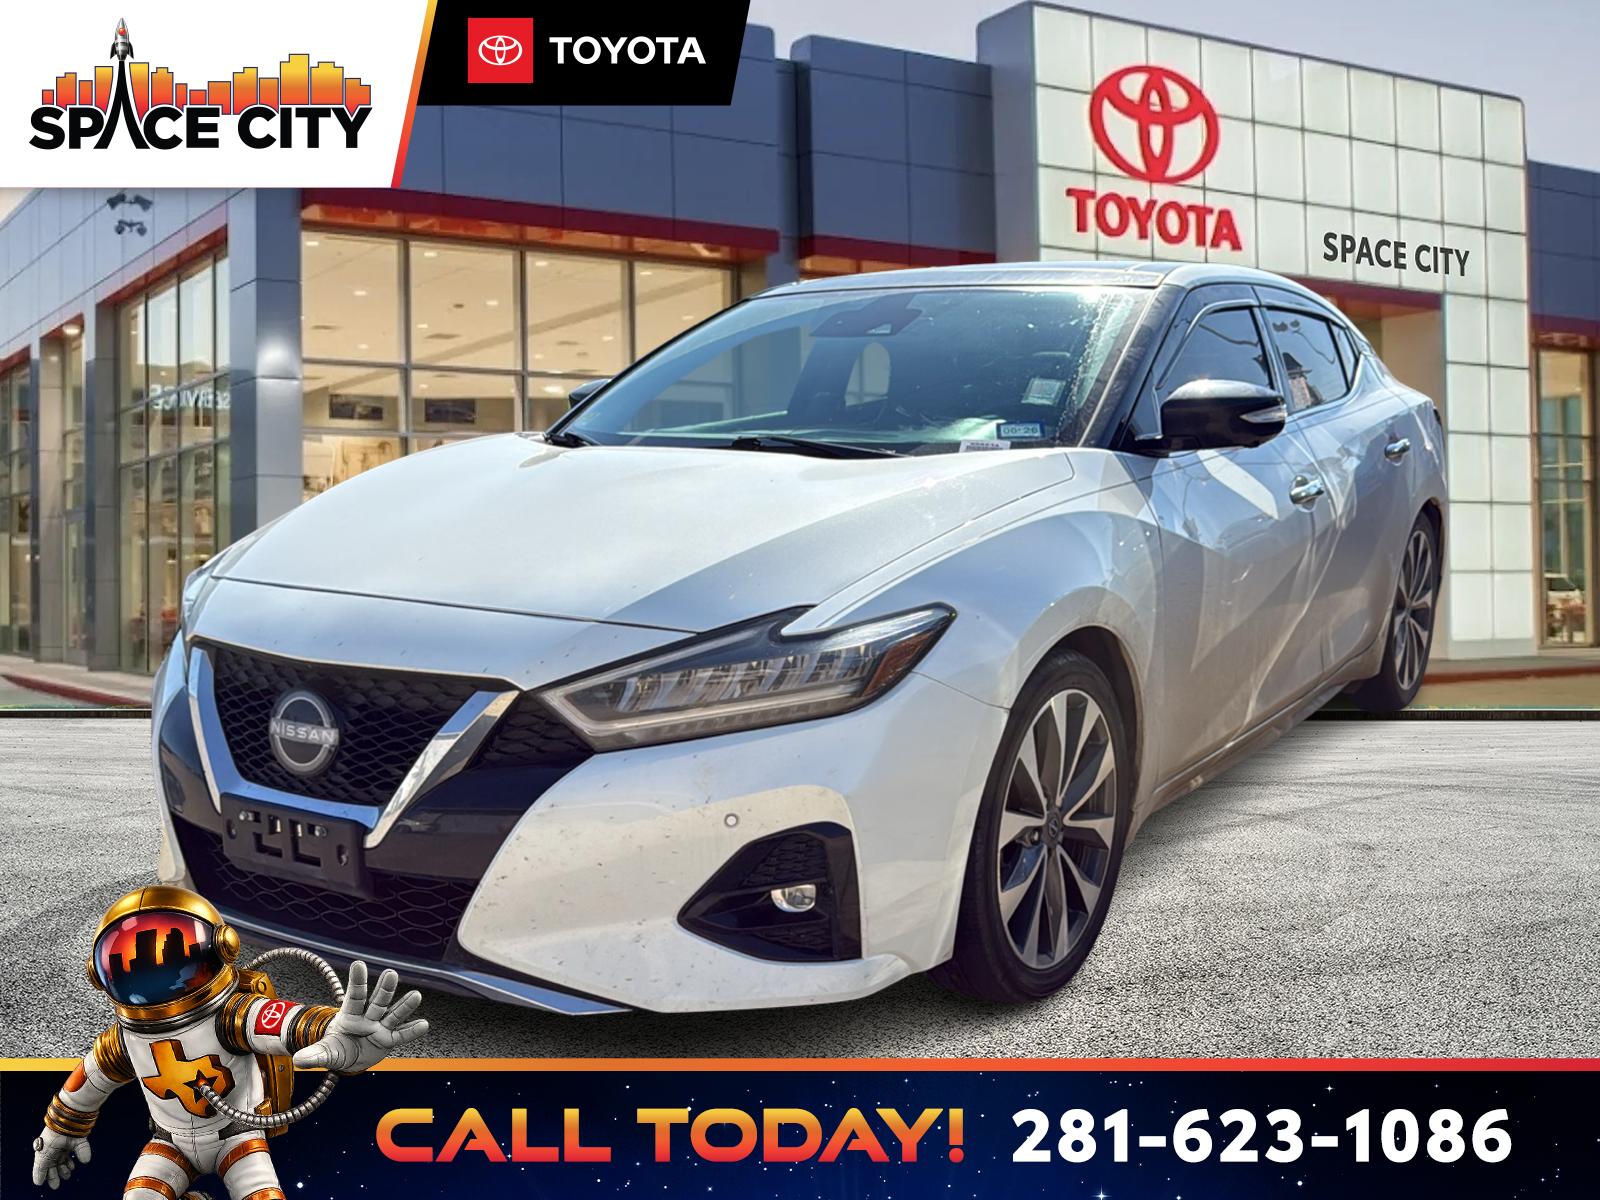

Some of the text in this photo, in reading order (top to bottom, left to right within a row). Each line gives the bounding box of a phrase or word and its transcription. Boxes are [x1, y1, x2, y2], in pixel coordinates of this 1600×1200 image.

[1066, 188, 1242, 250] TOYOTA
[1323, 232, 1470, 277] SPACE CITY
[270, 720, 336, 742] NISSAN
